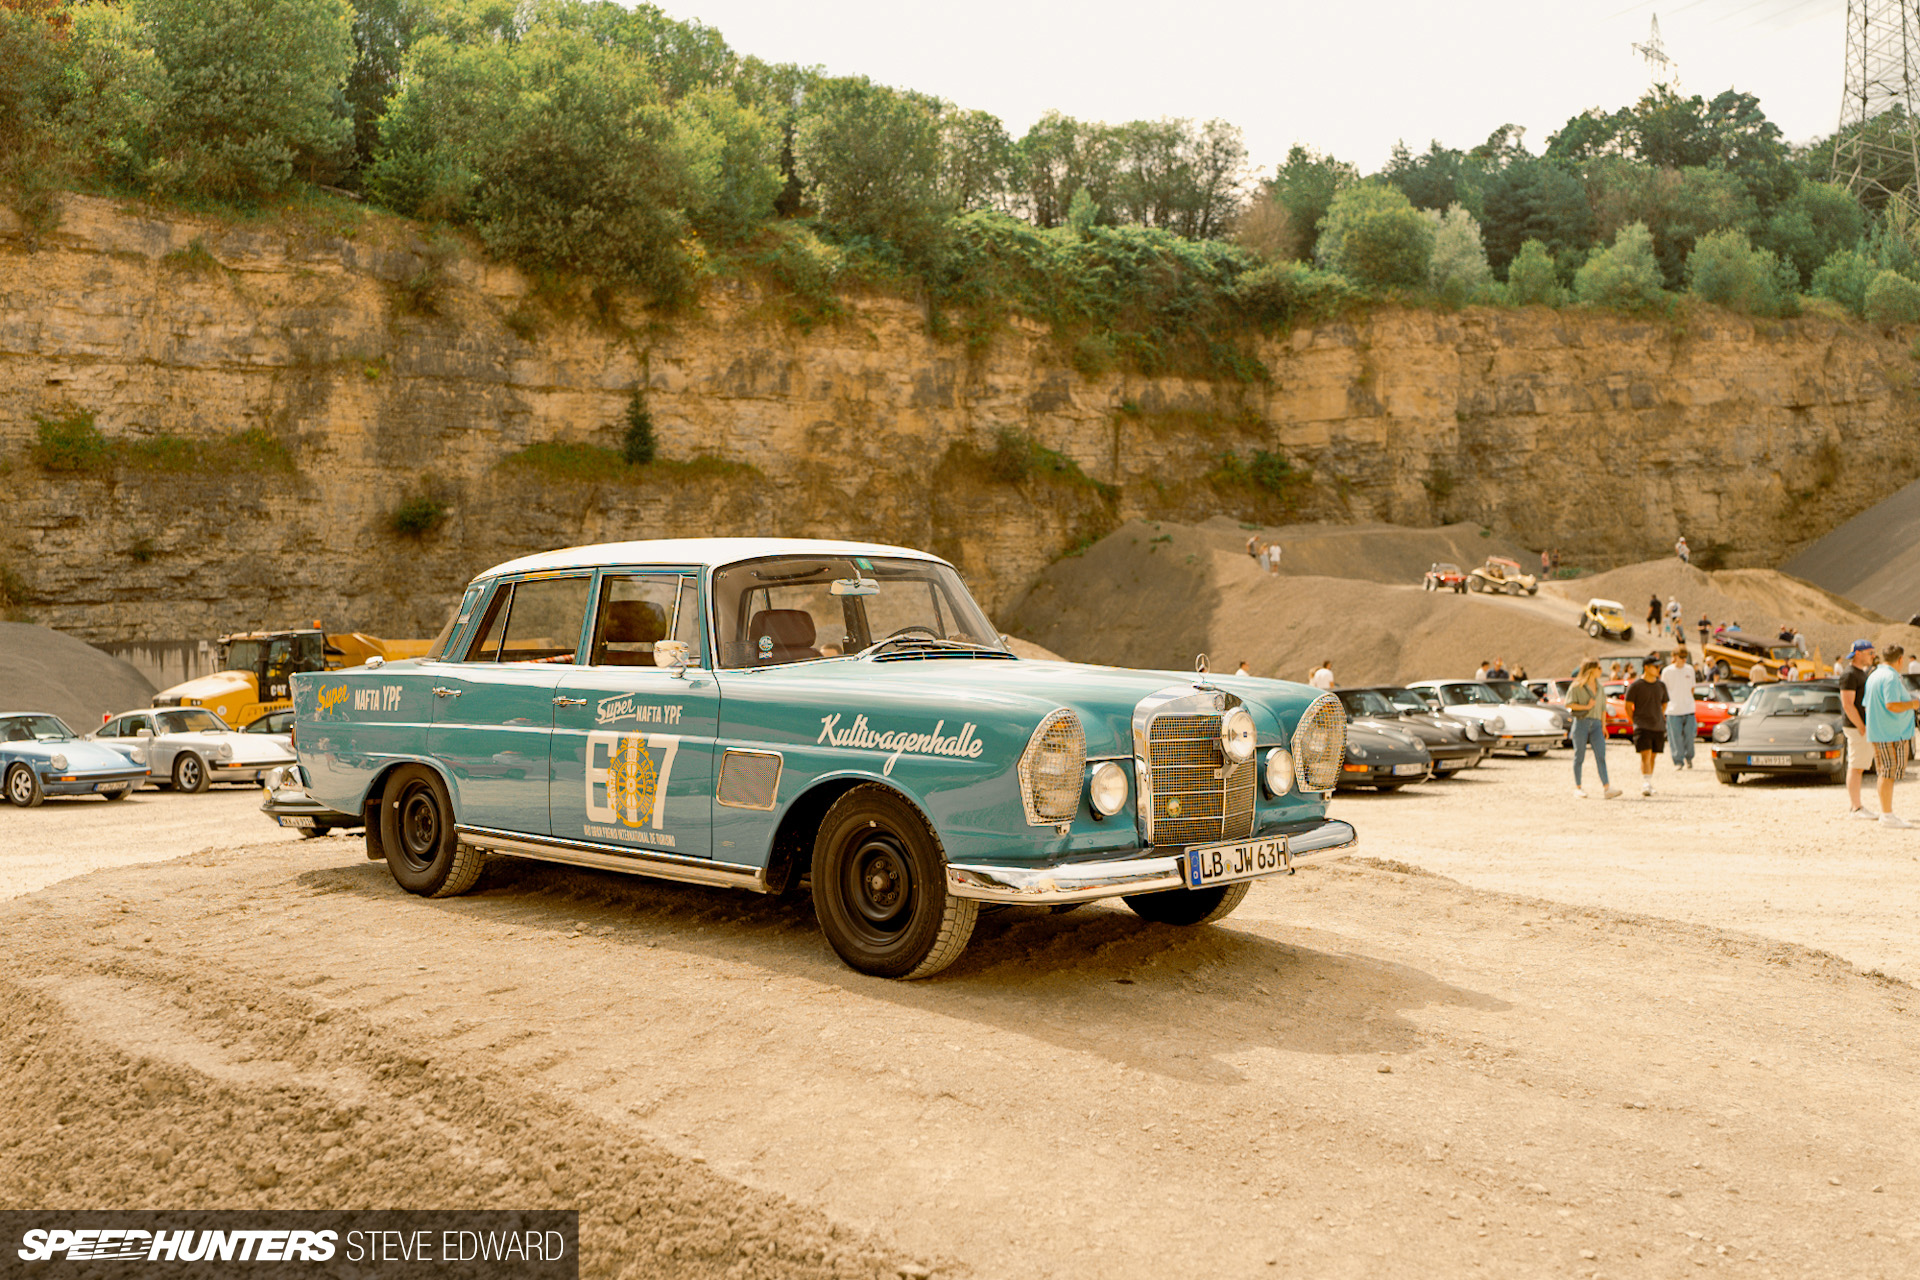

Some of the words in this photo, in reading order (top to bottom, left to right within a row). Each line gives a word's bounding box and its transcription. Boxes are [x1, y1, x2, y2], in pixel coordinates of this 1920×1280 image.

[270, 684, 287, 697] CAT
[316, 684, 350, 716] Super
[354, 689, 380, 711] NAFTA
[383, 685, 403, 711] YPF
[595, 692, 636, 724] Super
[636, 705, 662, 723] NAFTA
[664, 705, 683, 725] YPF
[817, 712, 983, 777] Kultwagenhalle
[1201, 852, 1223, 878] LB
[1234, 846, 1253, 873] JW
[1257, 842, 1287, 869] 63H
